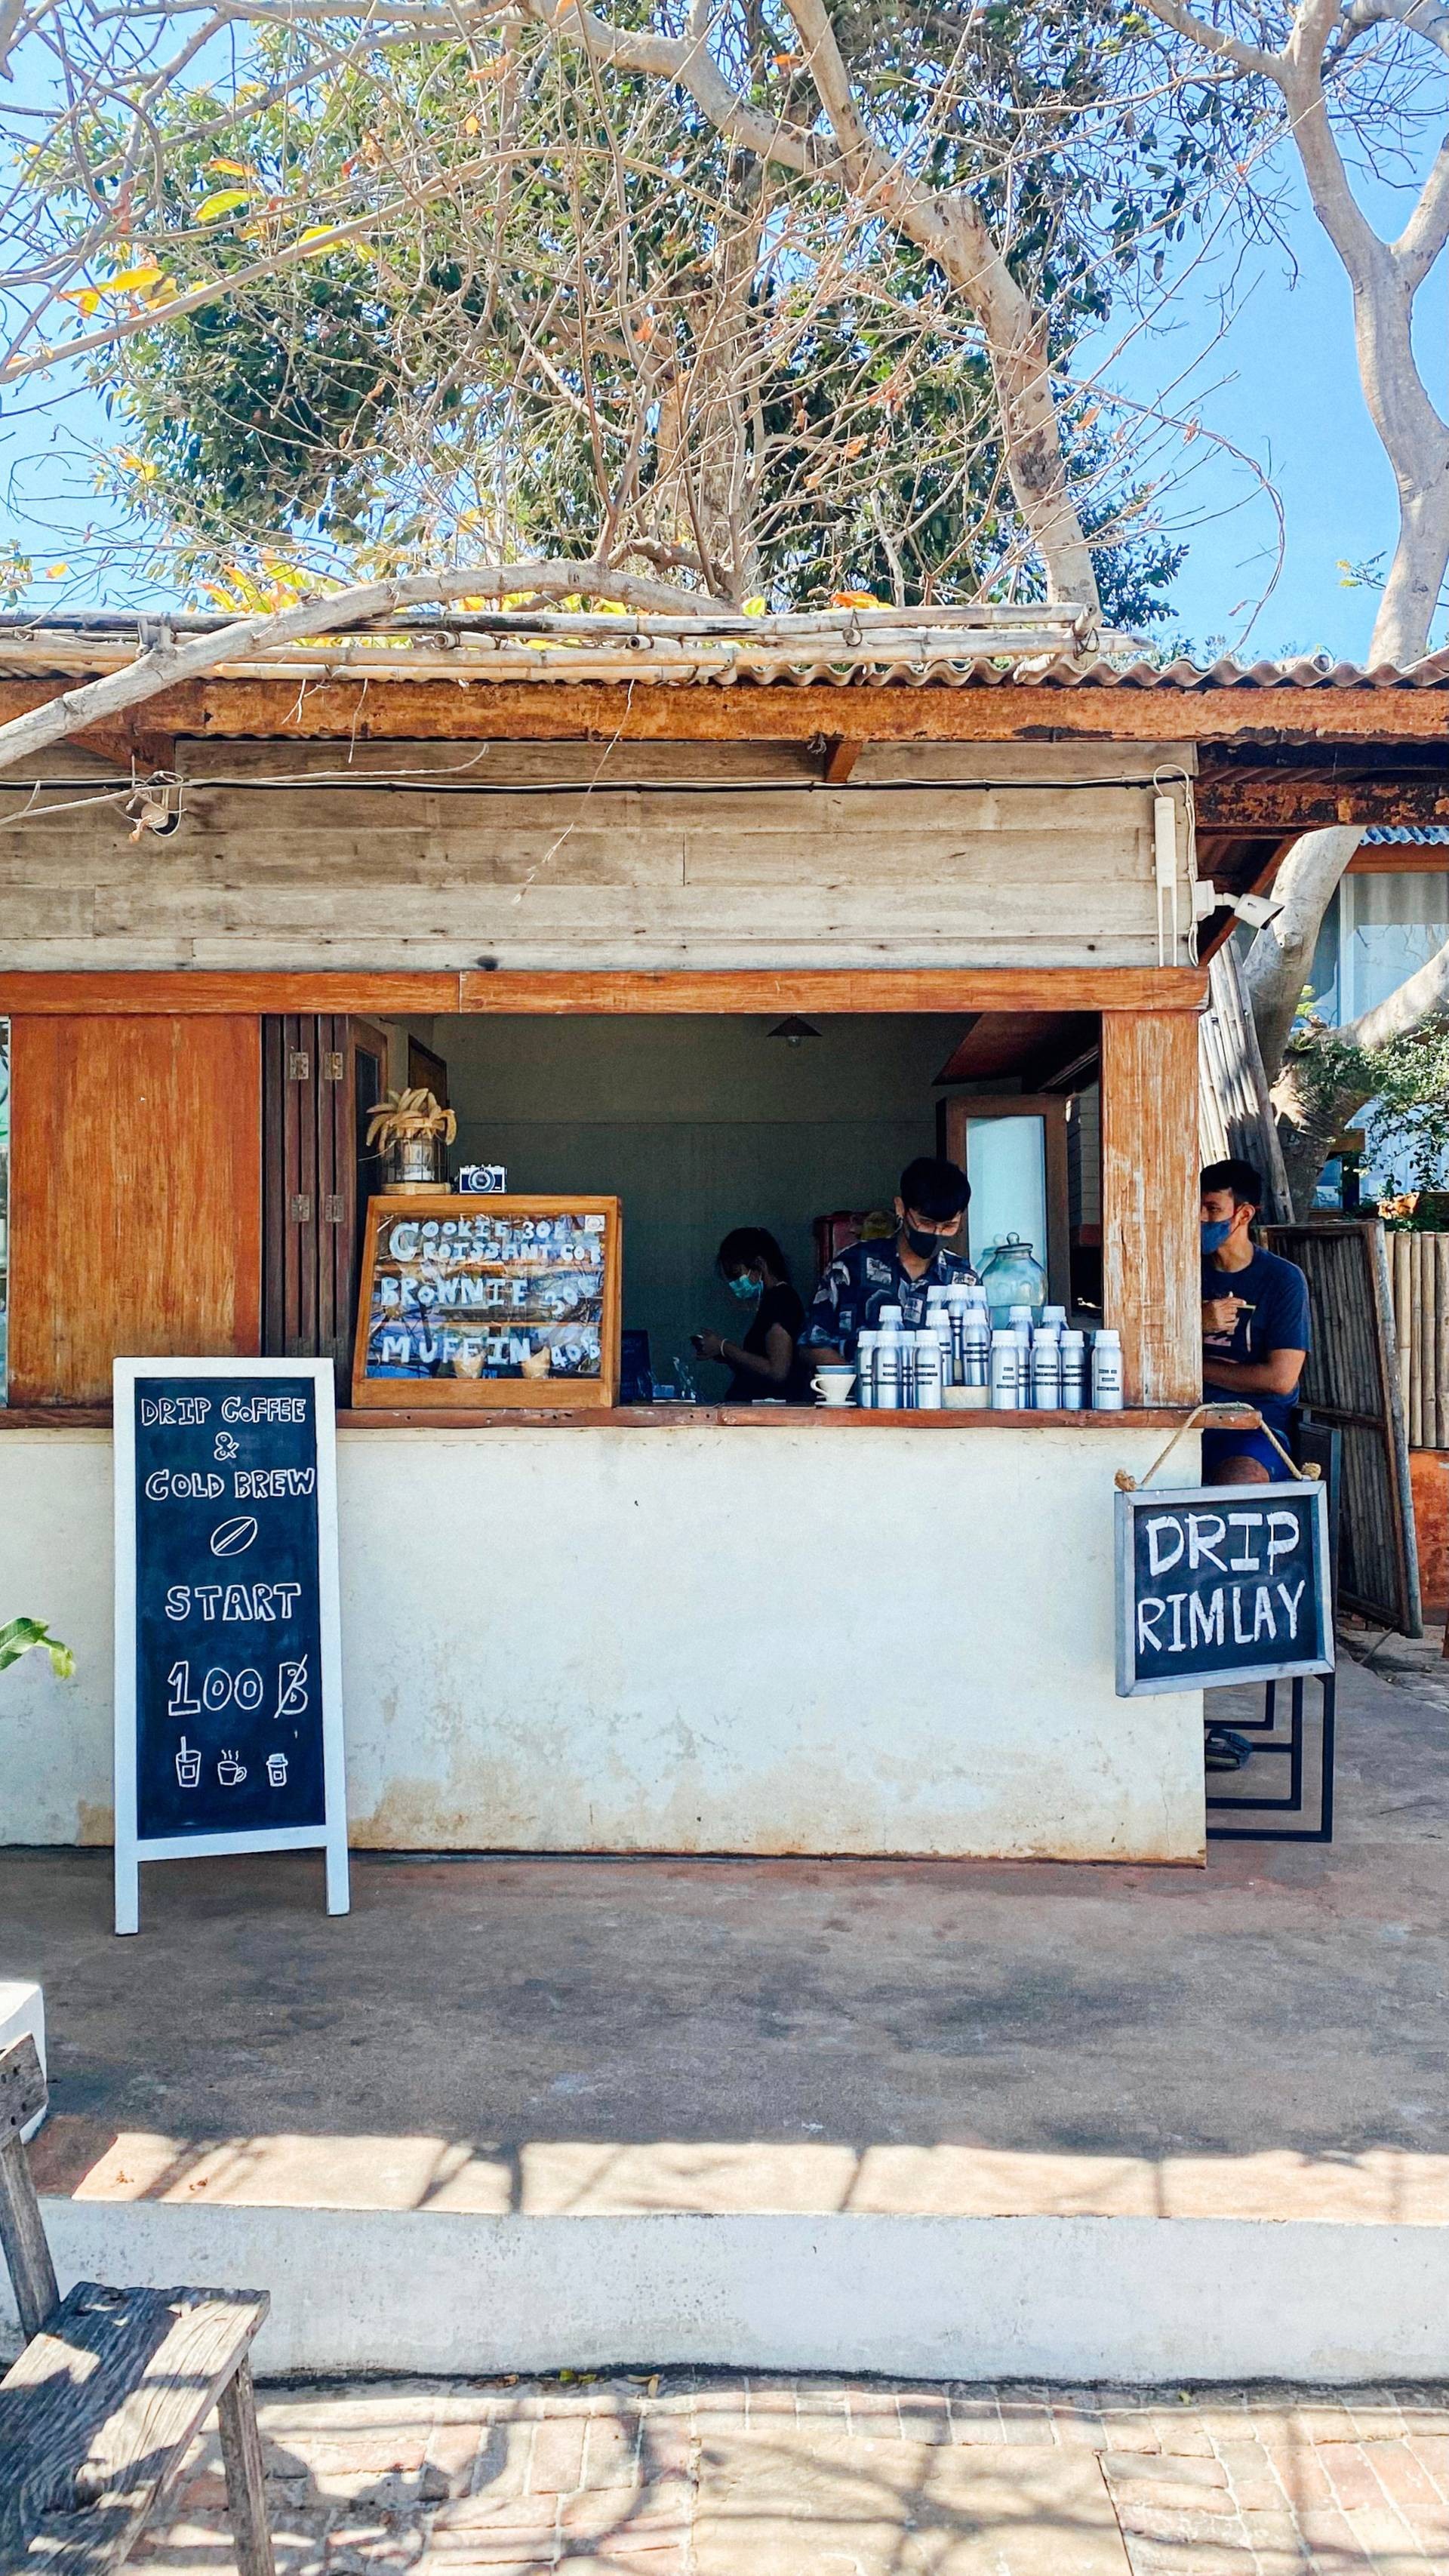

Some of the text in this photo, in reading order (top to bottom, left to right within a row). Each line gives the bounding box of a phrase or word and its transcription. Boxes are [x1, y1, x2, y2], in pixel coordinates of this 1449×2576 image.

[381, 1276, 528, 1306] BROWNIE
[382, 1336, 531, 1365] MUFFIN
[140, 1396, 306, 1426] DRIP COFFEE
[214, 1432, 239, 1460] &
[145, 1467, 315, 1500] COLD BREW
[1145, 1510, 1300, 1577] DRIP
[165, 1583, 301, 1621] START
[1137, 1579, 1306, 1654] RIMLAY
